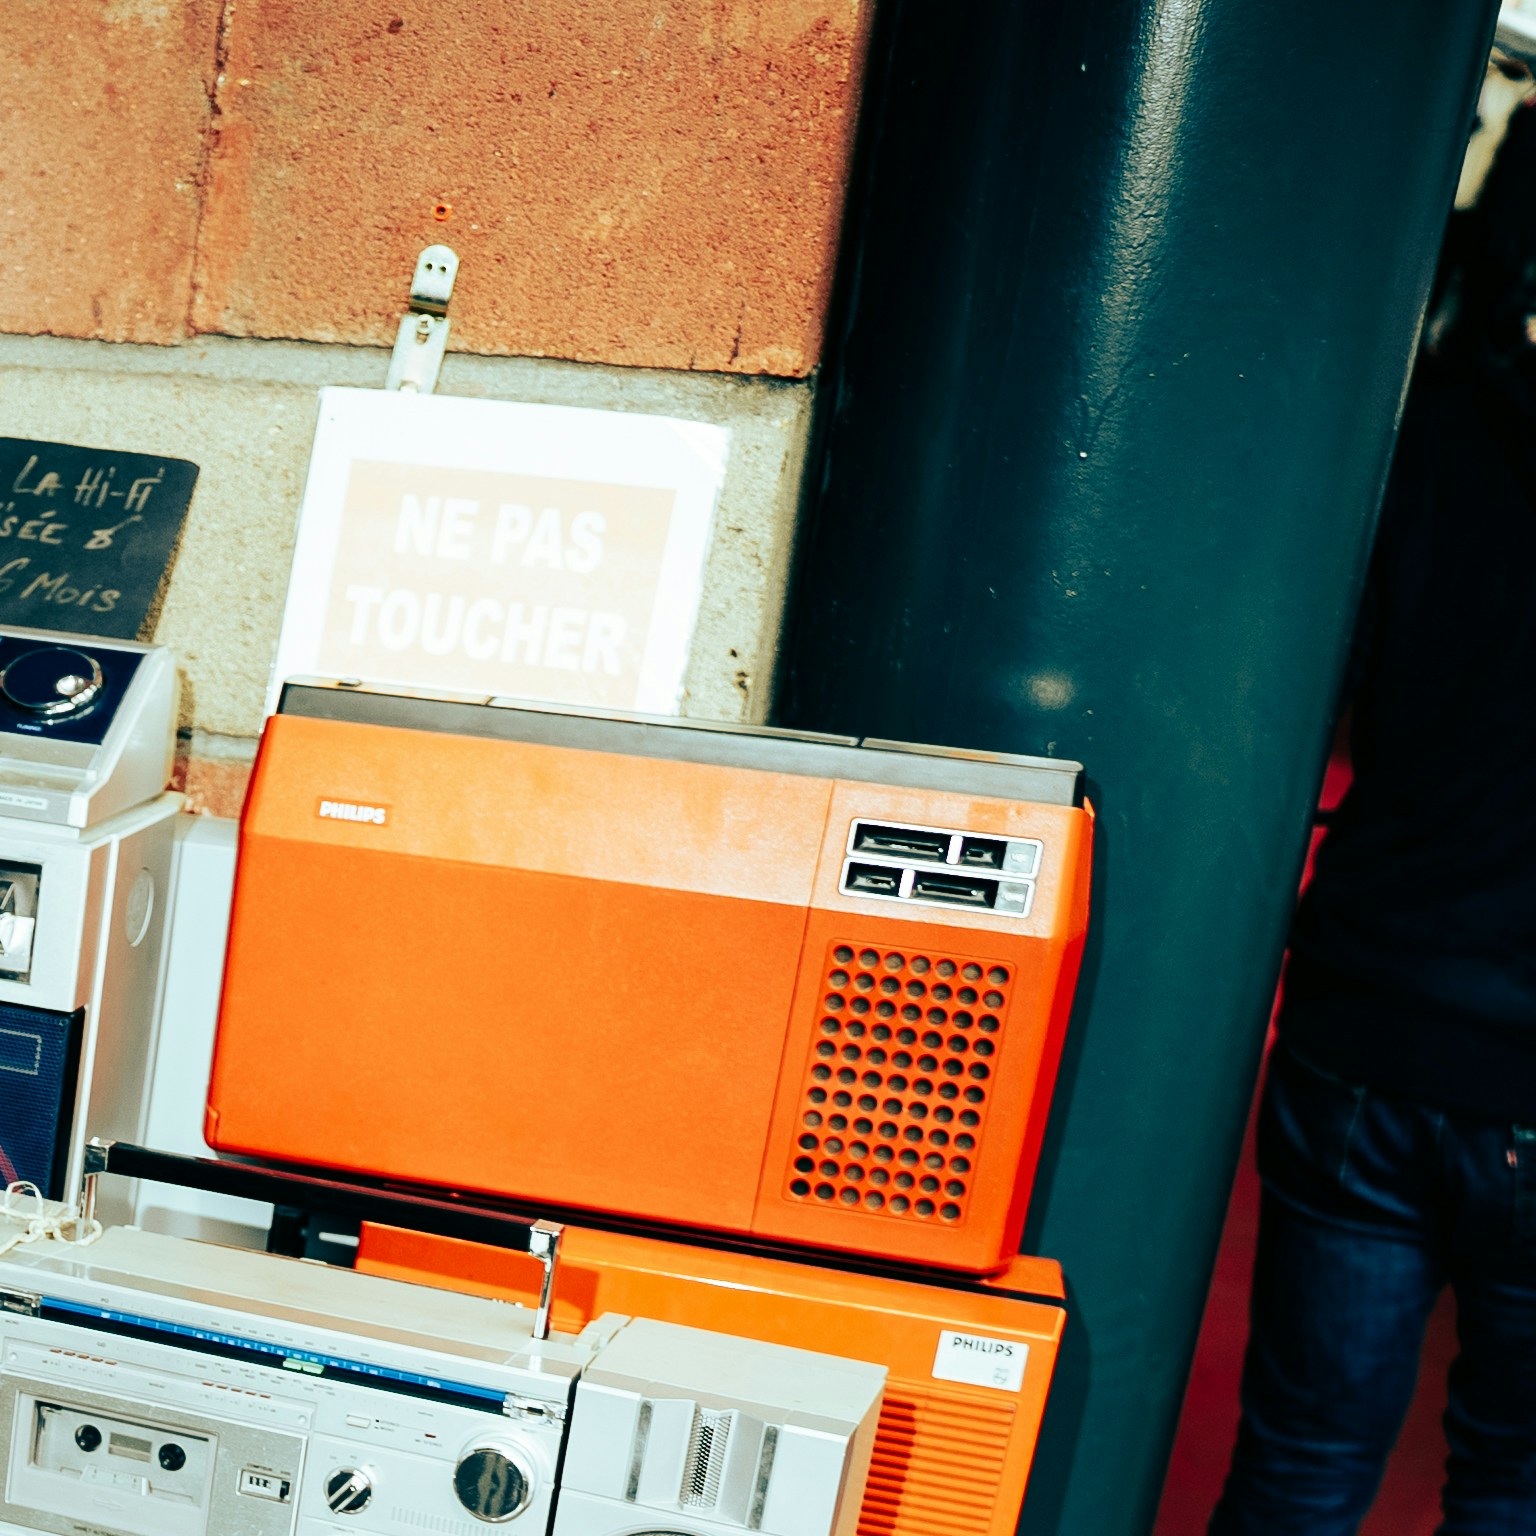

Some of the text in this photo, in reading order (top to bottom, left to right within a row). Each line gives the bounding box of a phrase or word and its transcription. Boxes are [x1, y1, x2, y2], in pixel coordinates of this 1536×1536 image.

[13, 455, 63, 497] LA
[394, 493, 607, 574] NE PAS
[344, 584, 627, 678] TOUCHER
[319, 801, 387, 826] PHILIPS
[952, 1333, 1015, 1361] PHILIPS
